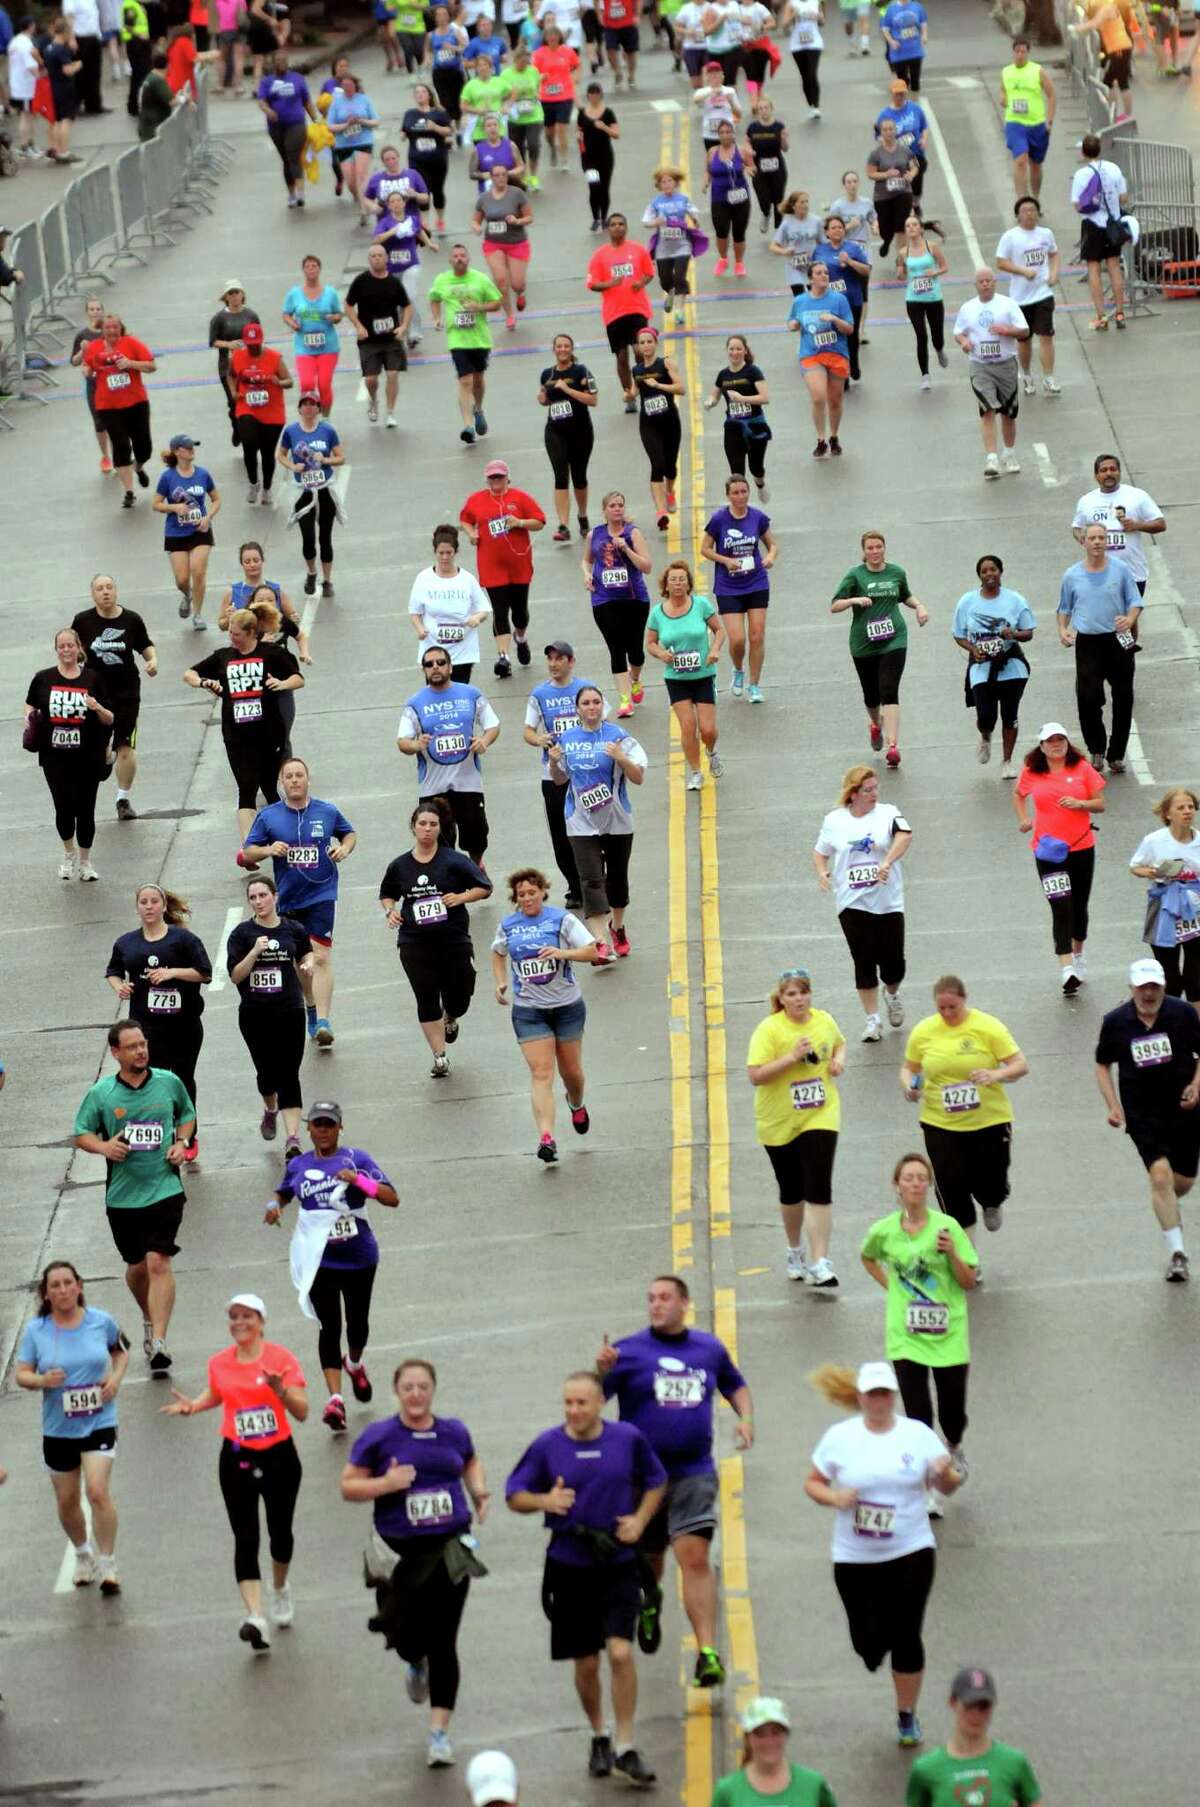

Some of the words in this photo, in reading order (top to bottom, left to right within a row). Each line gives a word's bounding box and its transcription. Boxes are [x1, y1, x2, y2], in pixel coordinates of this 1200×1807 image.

[490, 518, 510, 532] 832
[1106, 534, 1124, 544] 101
[438, 628, 463, 638] 4629
[868, 622, 893, 635] 1056
[674, 655, 699, 666] 6092
[226, 663, 264, 678] RUN
[228, 677, 263, 693] RPI
[50, 691, 87, 706] RUN
[546, 697, 571, 707] NYS
[50, 705, 86, 719] RPI
[236, 704, 262, 718] 7123
[424, 701, 453, 714] NYS
[53, 732, 78, 742] 7044
[438, 737, 465, 751] 6130
[566, 742, 592, 751] NYS
[582, 786, 610, 807] 6096
[288, 849, 318, 862] 9283
[848, 866, 878, 882] 4238
[419, 903, 441, 917] 679
[1176, 920, 1200, 934] 594
[523, 960, 554, 975] 6074
[254, 973, 276, 986] 856
[154, 994, 176, 1006] 779
[1136, 1041, 1170, 1061] 3994
[794, 1086, 824, 1102] 4275
[945, 1088, 976, 1105] 4277
[128, 1126, 161, 1142] 7699
[301, 1176, 338, 1197] Runnin
[328, 1221, 352, 1236] 94
[910, 1311, 947, 1325] 1552
[665, 1382, 693, 1397] 257
[71, 1393, 97, 1408] 594
[237, 1410, 276, 1432] 3439
[410, 1498, 450, 1516] 6784
